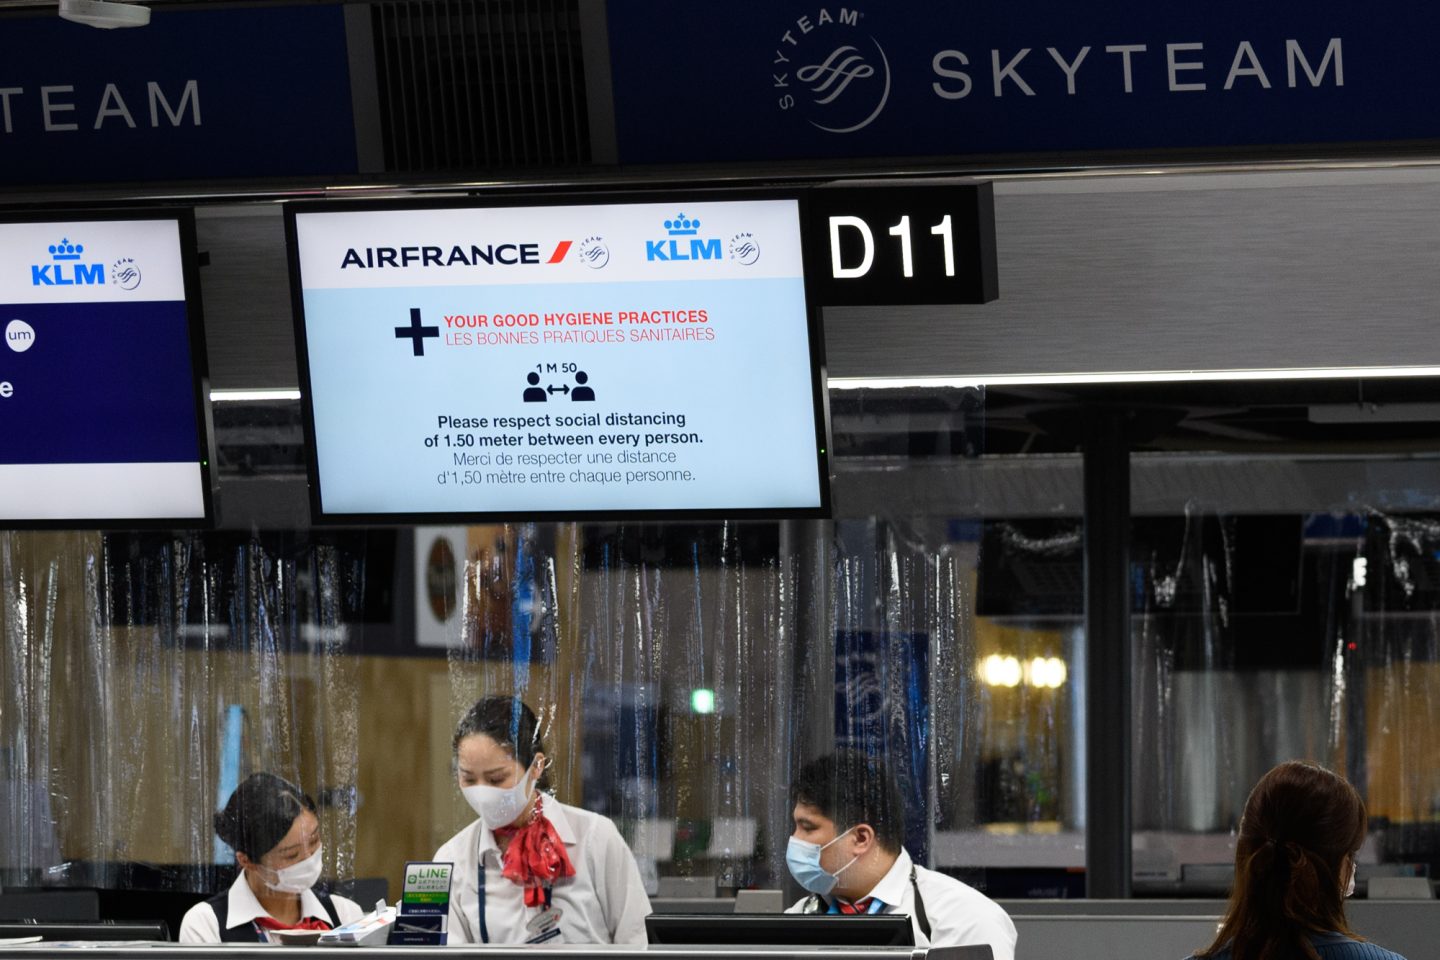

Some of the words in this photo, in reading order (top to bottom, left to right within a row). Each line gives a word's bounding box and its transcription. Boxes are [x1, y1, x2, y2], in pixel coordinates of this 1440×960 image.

[773, 8, 859, 110] SKYTEAM
[931, 37, 1345, 100] SKYTEAM
[646, 239, 722, 262] KLM
[829, 214, 955, 278] D11
[340, 243, 541, 270] AIRFRANCE
[32, 264, 105, 286] KLM
[444, 315, 488, 328] YOUR
[493, 313, 540, 327] GOOD
[544, 312, 614, 326] HYGIENE
[618, 310, 708, 325] PRACTICES
[8, 331, 32, 341] um
[446, 332, 473, 345] LES
[477, 331, 539, 345] BONNES
[543, 329, 626, 344] PRATIQUES
[630, 327, 715, 342] SANITAIRES
[536, 363, 543, 374] 1
[546, 363, 558, 373] M
[561, 362, 578, 373] 50
[438, 415, 488, 428] Please
[493, 414, 551, 430] respect
[555, 413, 600, 427] social
[605, 412, 686, 428] distancing
[424, 434, 439, 447] of
[444, 434, 474, 447] 1.50
[479, 434, 523, 447] meter
[528, 433, 594, 446] between
[598, 433, 640, 447] every
[645, 432, 703, 447] person.
[453, 452, 491, 466] Merci
[495, 452, 513, 465] de
[517, 451, 582, 467] respecter
[587, 452, 613, 464] une
[617, 450, 677, 463] distance
[437, 470, 482, 485] d'1,50
[486, 470, 526, 484] mètre
[530, 470, 566, 483] entre
[569, 469, 622, 485] chaque
[626, 469, 696, 485] personne.
[418, 868, 448, 878] LINE
